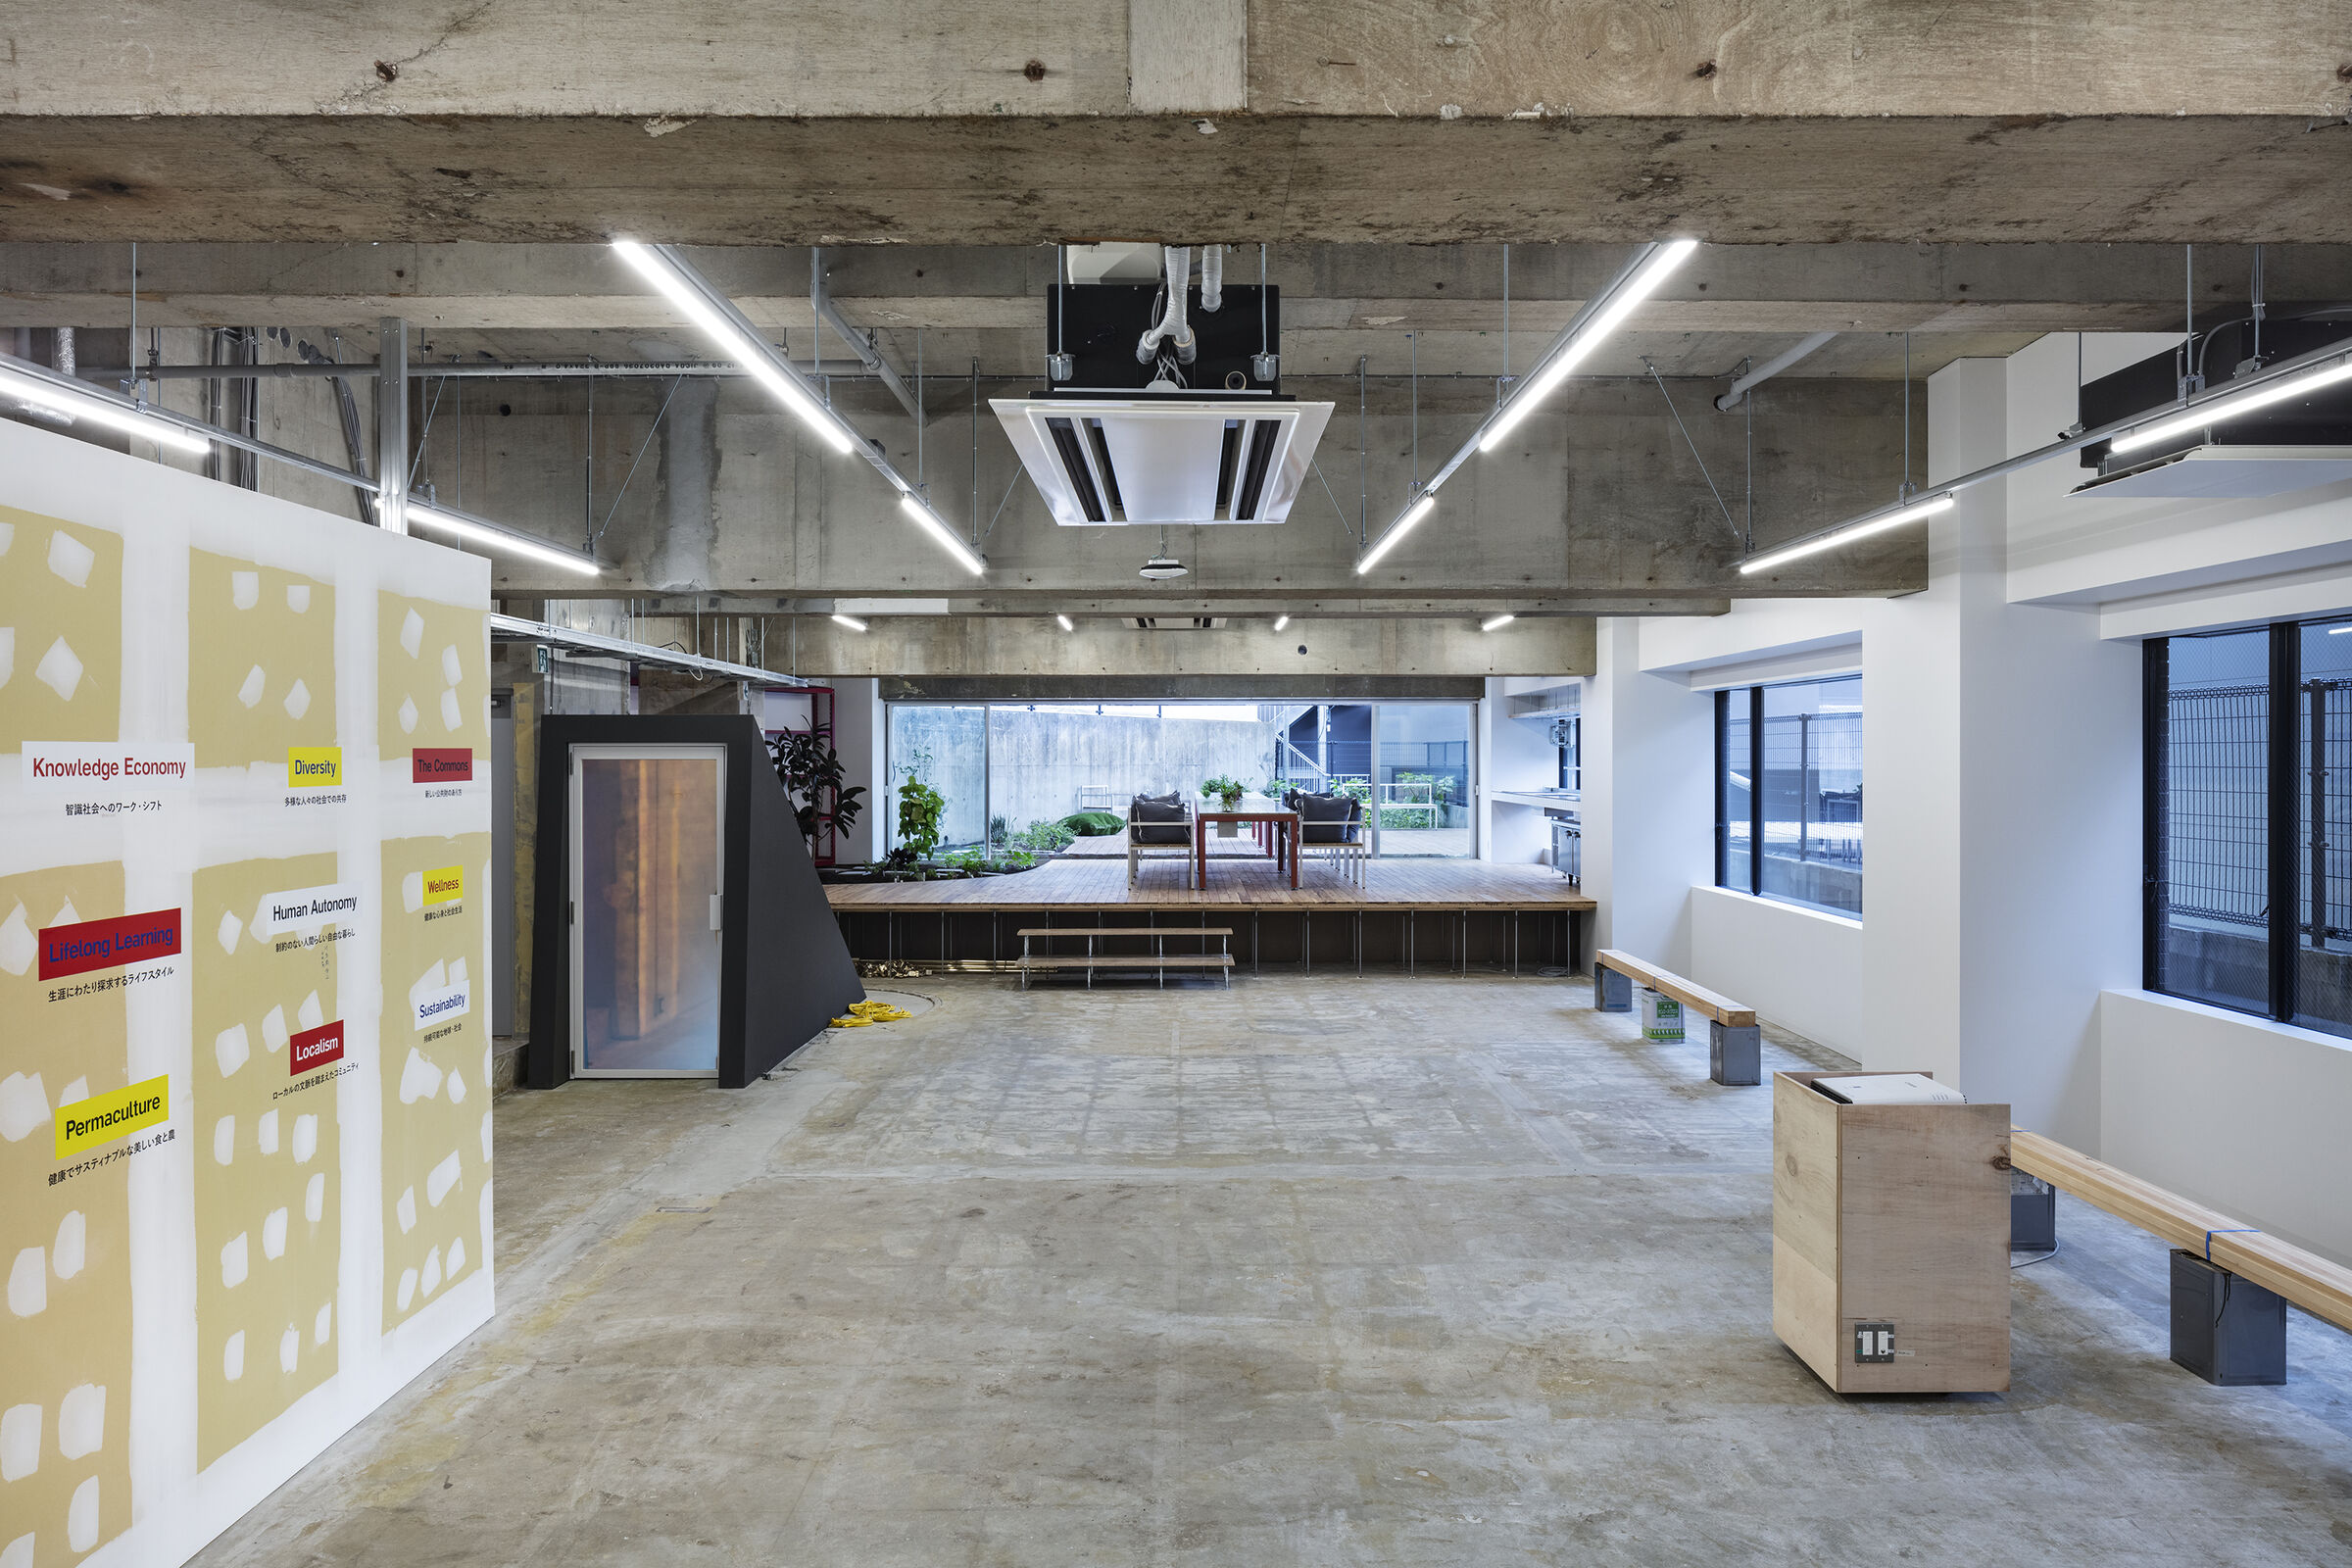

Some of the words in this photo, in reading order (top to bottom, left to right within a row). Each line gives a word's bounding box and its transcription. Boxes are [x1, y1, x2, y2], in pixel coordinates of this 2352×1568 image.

[32, 757, 120, 781] Knowledge
[124, 757, 186, 779] Economy
[295, 759, 336, 778] Diversity
[417, 759, 432, 773] The
[434, 759, 469, 773] Commons
[427, 878, 460, 894] Wellness
[272, 904, 308, 921] Human
[311, 896, 358, 915] Autonomy
[49, 938, 111, 963] Lifelong
[115, 926, 173, 952] Learning
[48, 966, 174, 1003] 生涯にわたり探求するライフスタイル
[419, 993, 466, 1019] Sustainability
[296, 1036, 339, 1062] Localism
[66, 1096, 161, 1141] Permaculture
[48, 1128, 175, 1187] 健康でサスティナブルな美しい食と農
